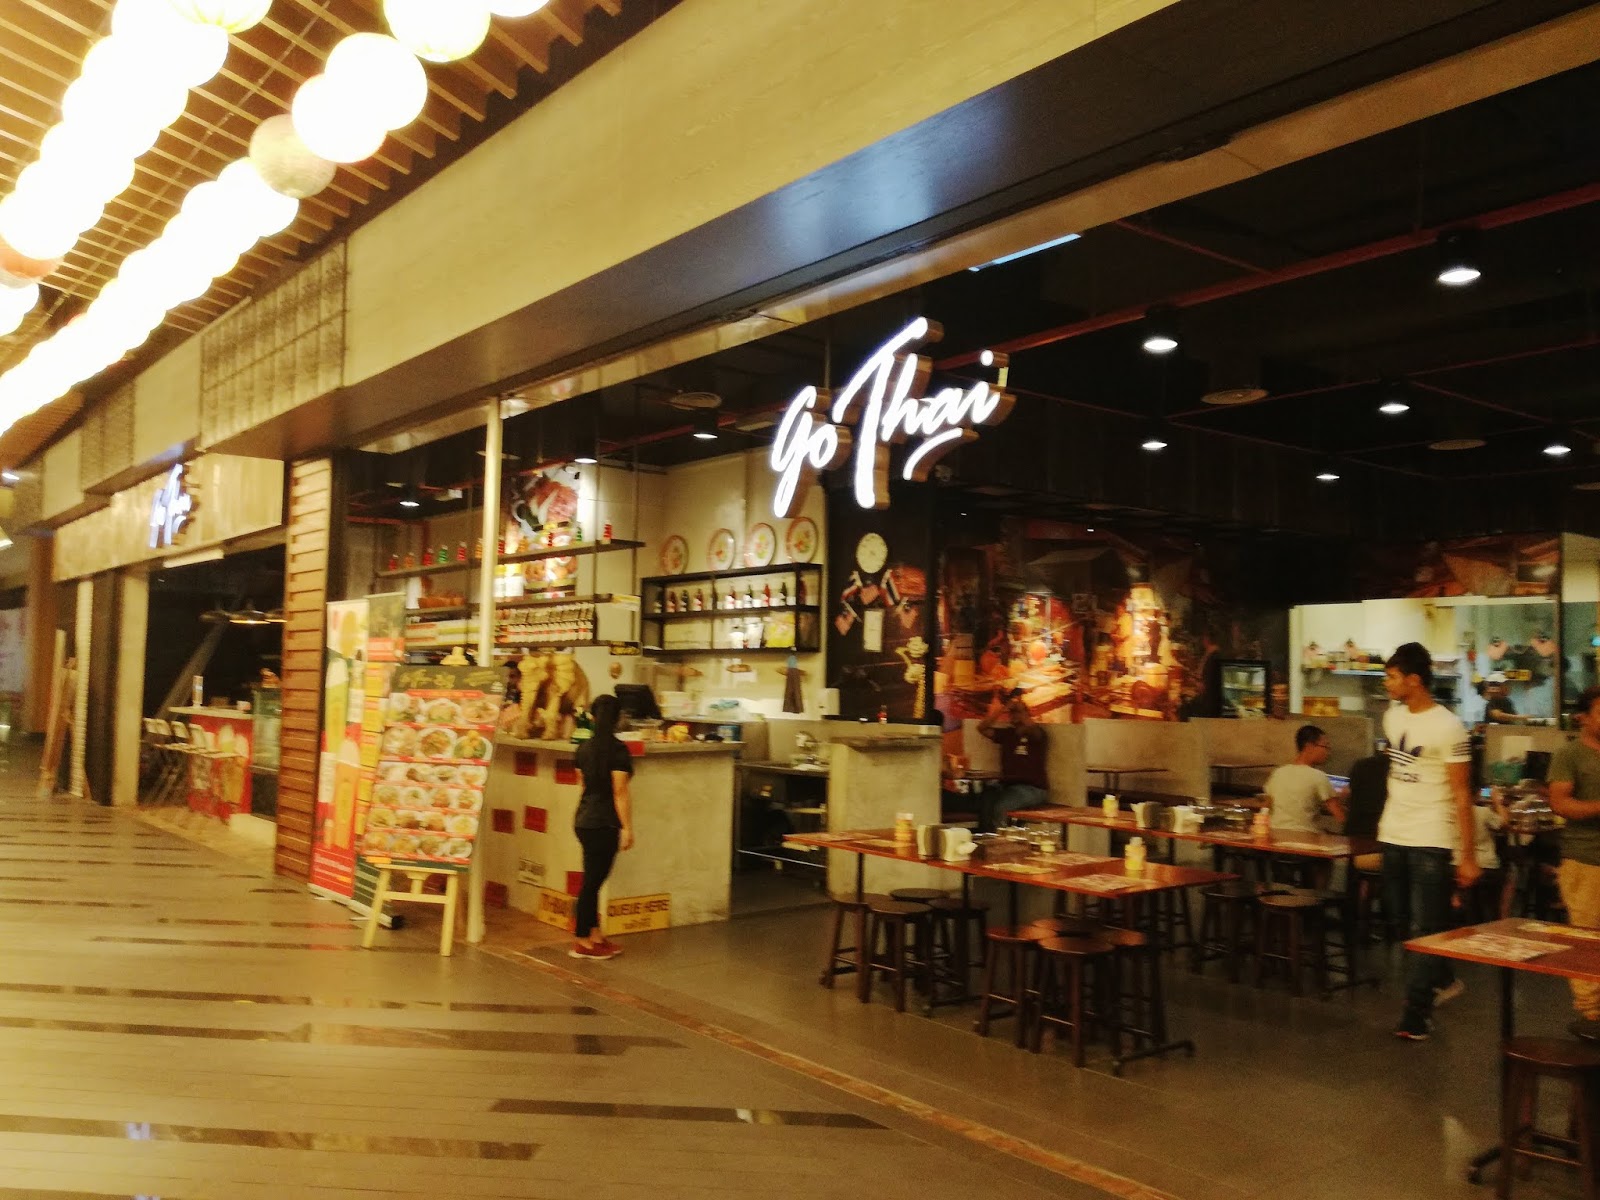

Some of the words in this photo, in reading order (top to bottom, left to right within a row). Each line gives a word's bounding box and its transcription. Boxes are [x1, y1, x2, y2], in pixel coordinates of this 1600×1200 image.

[771, 385, 838, 518] Go
[832, 316, 1001, 509] Thai
[607, 902, 642, 917] QUEUE
[643, 899, 670, 913] HERE
